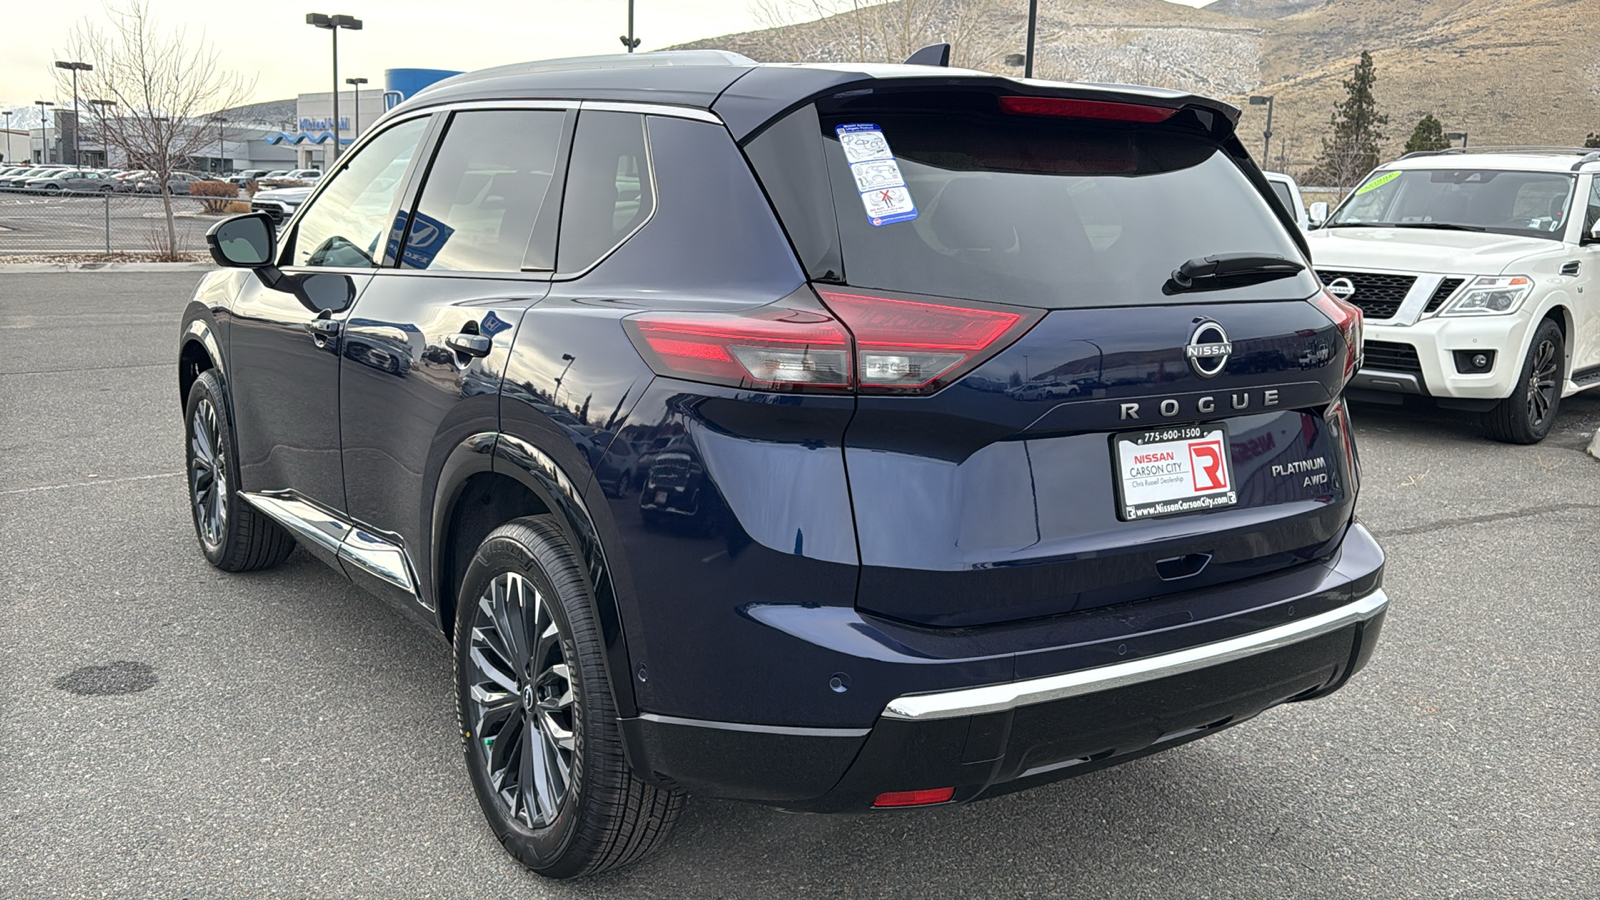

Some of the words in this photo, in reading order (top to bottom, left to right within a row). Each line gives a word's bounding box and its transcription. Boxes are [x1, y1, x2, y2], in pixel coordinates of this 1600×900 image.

[1188, 343, 1232, 356] NISSAN
[1120, 389, 1279, 420] ROGUE
[1144, 427, 1200, 442] 775-600-1500
[1134, 451, 1174, 465] NISSAN
[1129, 464, 1164, 478] CARSON
[1165, 462, 1182, 474] CITY
[1271, 456, 1326, 477] PLATINUM
[1131, 480, 1144, 488] Chris
[1145, 478, 1160, 486] Russell
[1160, 475, 1184, 486] Dealership
[1303, 473, 1327, 488] AWD
[1136, 496, 1228, 518] www.NissanCarsonCity.com
